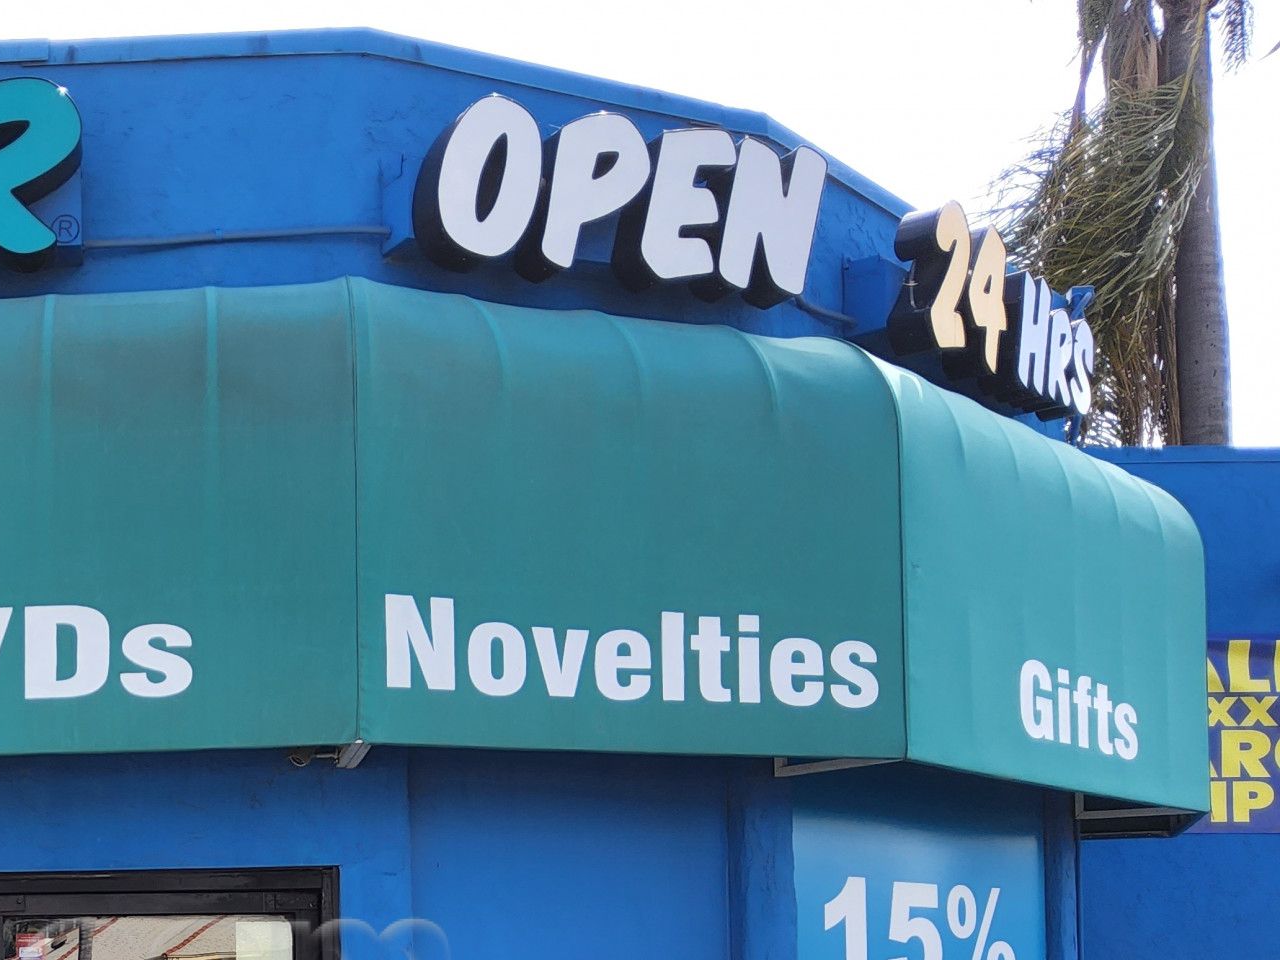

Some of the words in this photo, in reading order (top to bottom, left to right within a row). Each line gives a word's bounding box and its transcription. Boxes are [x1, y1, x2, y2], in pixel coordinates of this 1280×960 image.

[437, 93, 828, 296] OPEN
[930, 200, 1008, 375] 24
[1018, 270, 1094, 416] HRS
[384, 593, 879, 709] Novelties
[1019, 659, 1139, 761] Gifts
